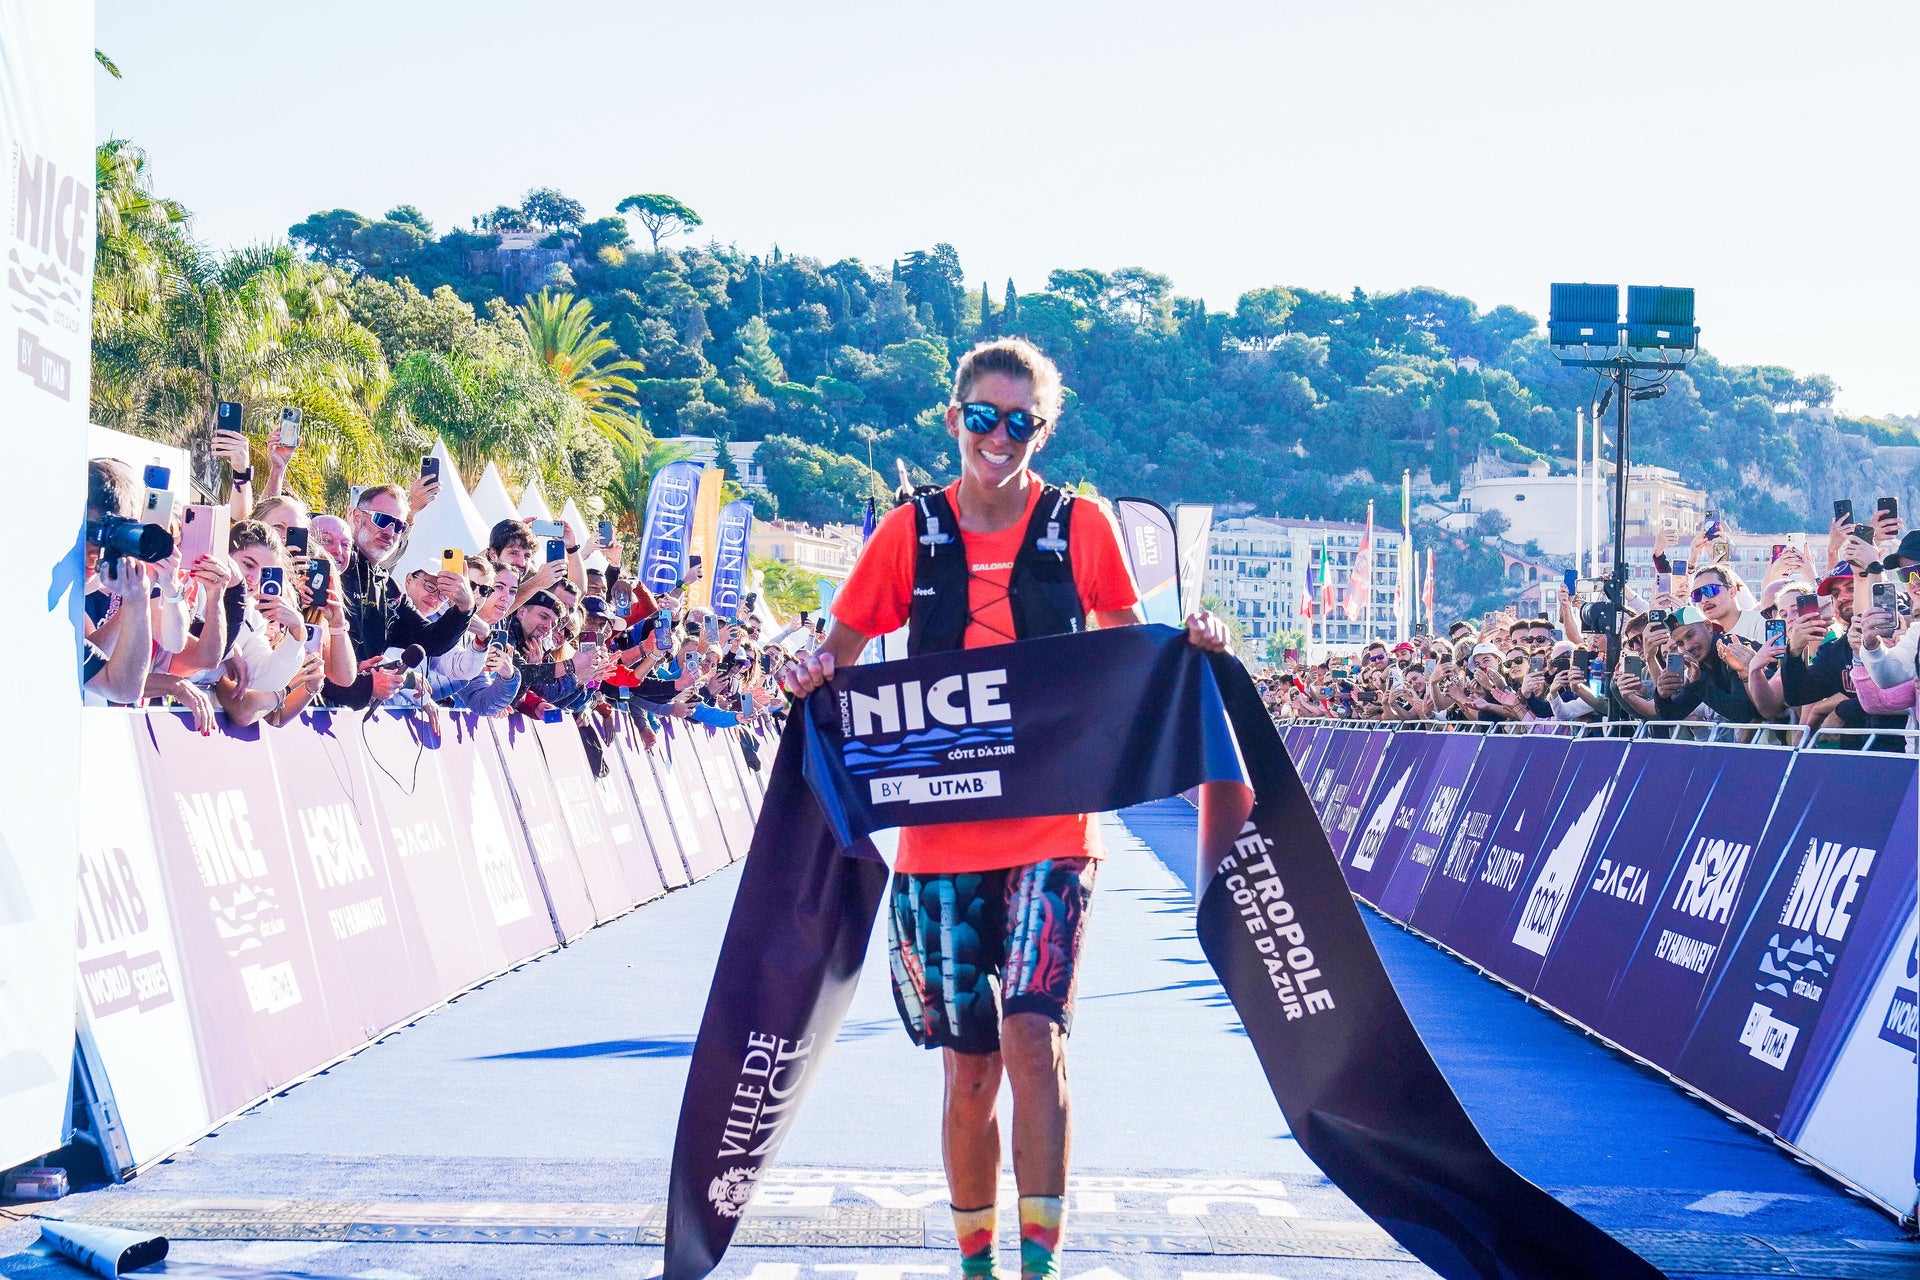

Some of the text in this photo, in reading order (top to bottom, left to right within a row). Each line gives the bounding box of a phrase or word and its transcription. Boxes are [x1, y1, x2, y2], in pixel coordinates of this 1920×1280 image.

[16, 146, 90, 277] NICE
[21, 340, 33, 366] BY
[653, 476, 692, 586] DE NICE
[721, 515, 746, 609] DE NICE
[839, 690, 850, 738] MÉTROPOLE
[850, 668, 1012, 737] NICE
[881, 777, 985, 797] BY UTMB
[947, 744, 1016, 761] CÔTE D'AZUR
[180, 788, 269, 888] NICE
[297, 802, 375, 890] HOKA
[1481, 844, 1525, 892] SUUNTO
[1592, 858, 1650, 906] DACIA
[1672, 837, 1751, 925] HOKA
[1783, 837, 1877, 942] NICE
[84, 961, 169, 1006] WORLD SERIES
[1225, 874, 1268, 935] CÔTE
[1255, 935, 1304, 1022] D'AZUR
[1654, 929, 1717, 975] FLY HUMAN FLY
[1761, 1025, 1788, 1059] UTMB
[717, 1031, 777, 1159] VILLE DE
[748, 1032, 816, 1157] NICE
